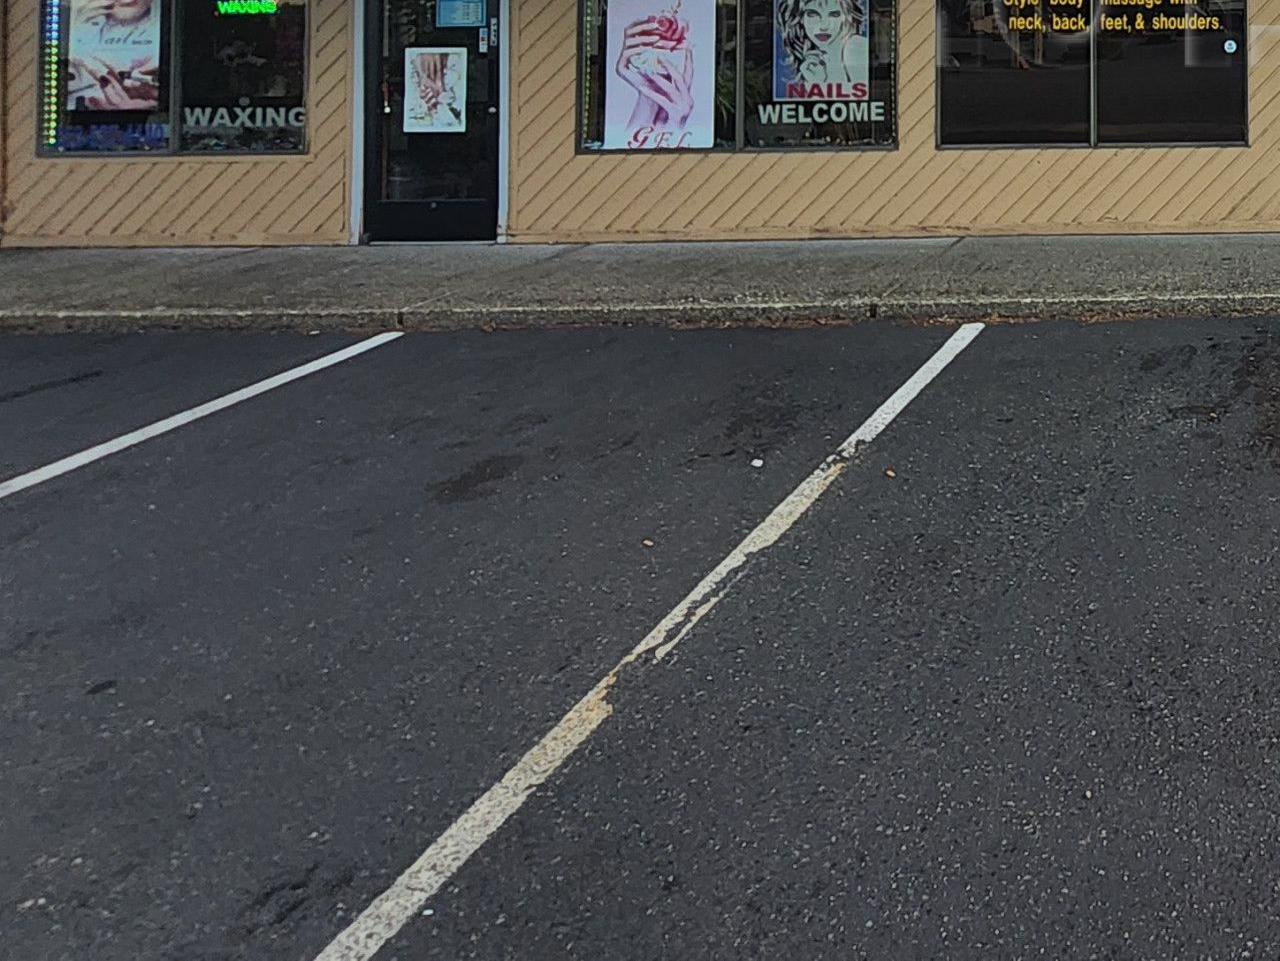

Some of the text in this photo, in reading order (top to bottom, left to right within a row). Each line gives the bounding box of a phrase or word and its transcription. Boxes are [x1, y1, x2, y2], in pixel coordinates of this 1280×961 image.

[1009, 13, 1224, 33] neck, back, feet, & shoulders.
[786, 82, 868, 99] NAILS
[184, 107, 306, 127] WAXING
[758, 102, 885, 124] WELCOME
